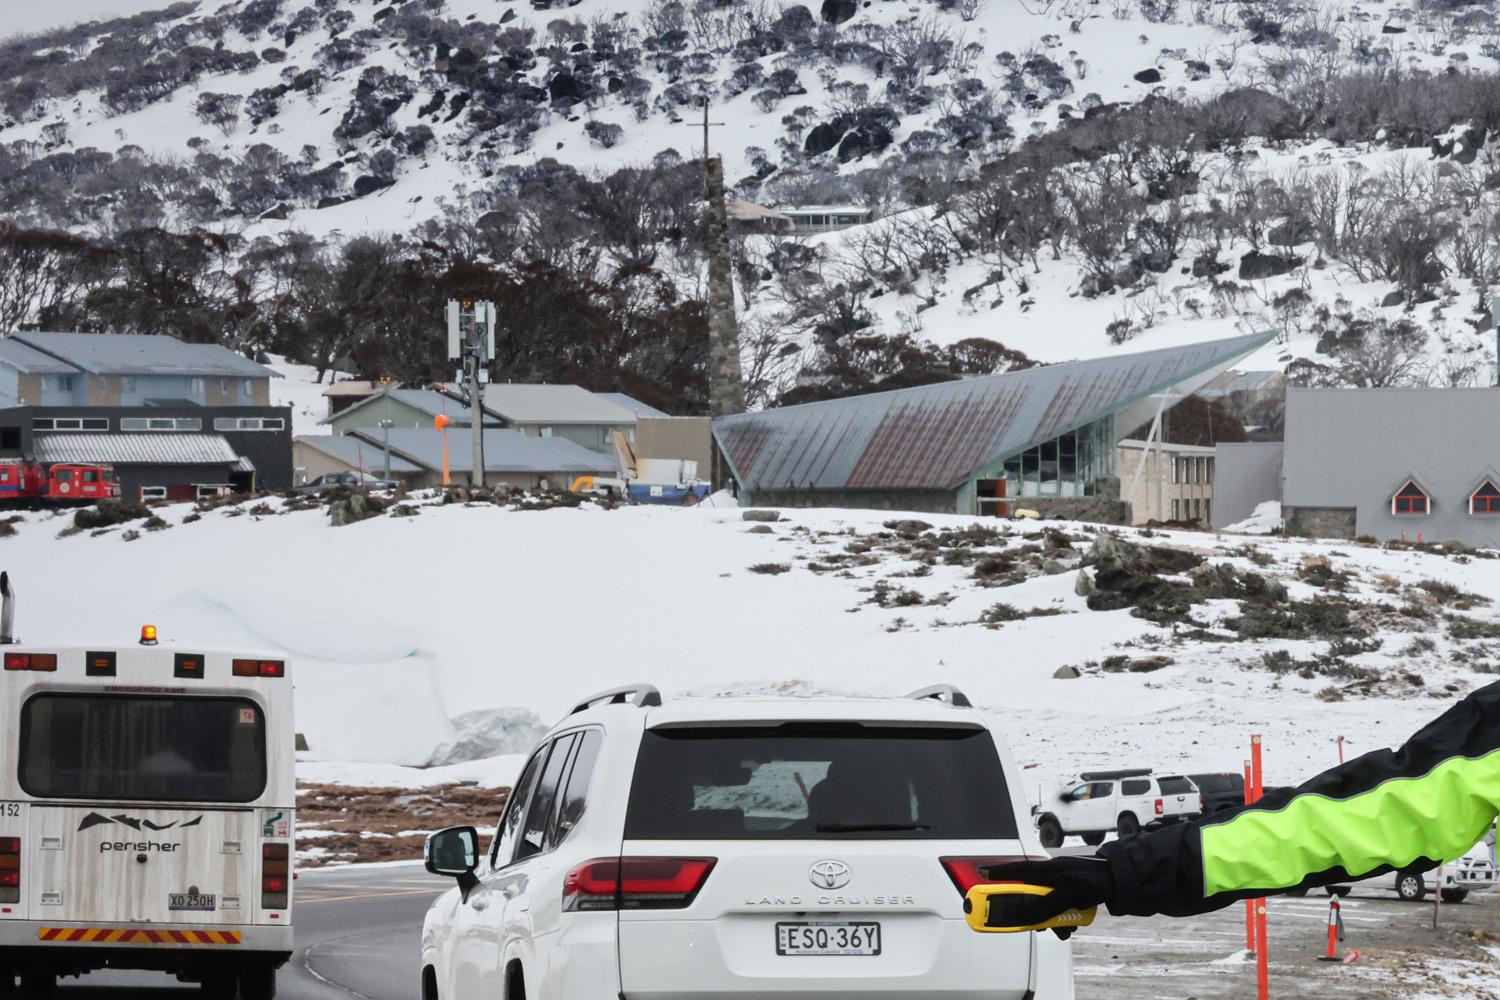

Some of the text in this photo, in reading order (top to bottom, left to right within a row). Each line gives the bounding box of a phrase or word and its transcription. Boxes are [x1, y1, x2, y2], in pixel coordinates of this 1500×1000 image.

[100, 840, 181, 854] perisher
[745, 896, 915, 905] LAND CRUISER
